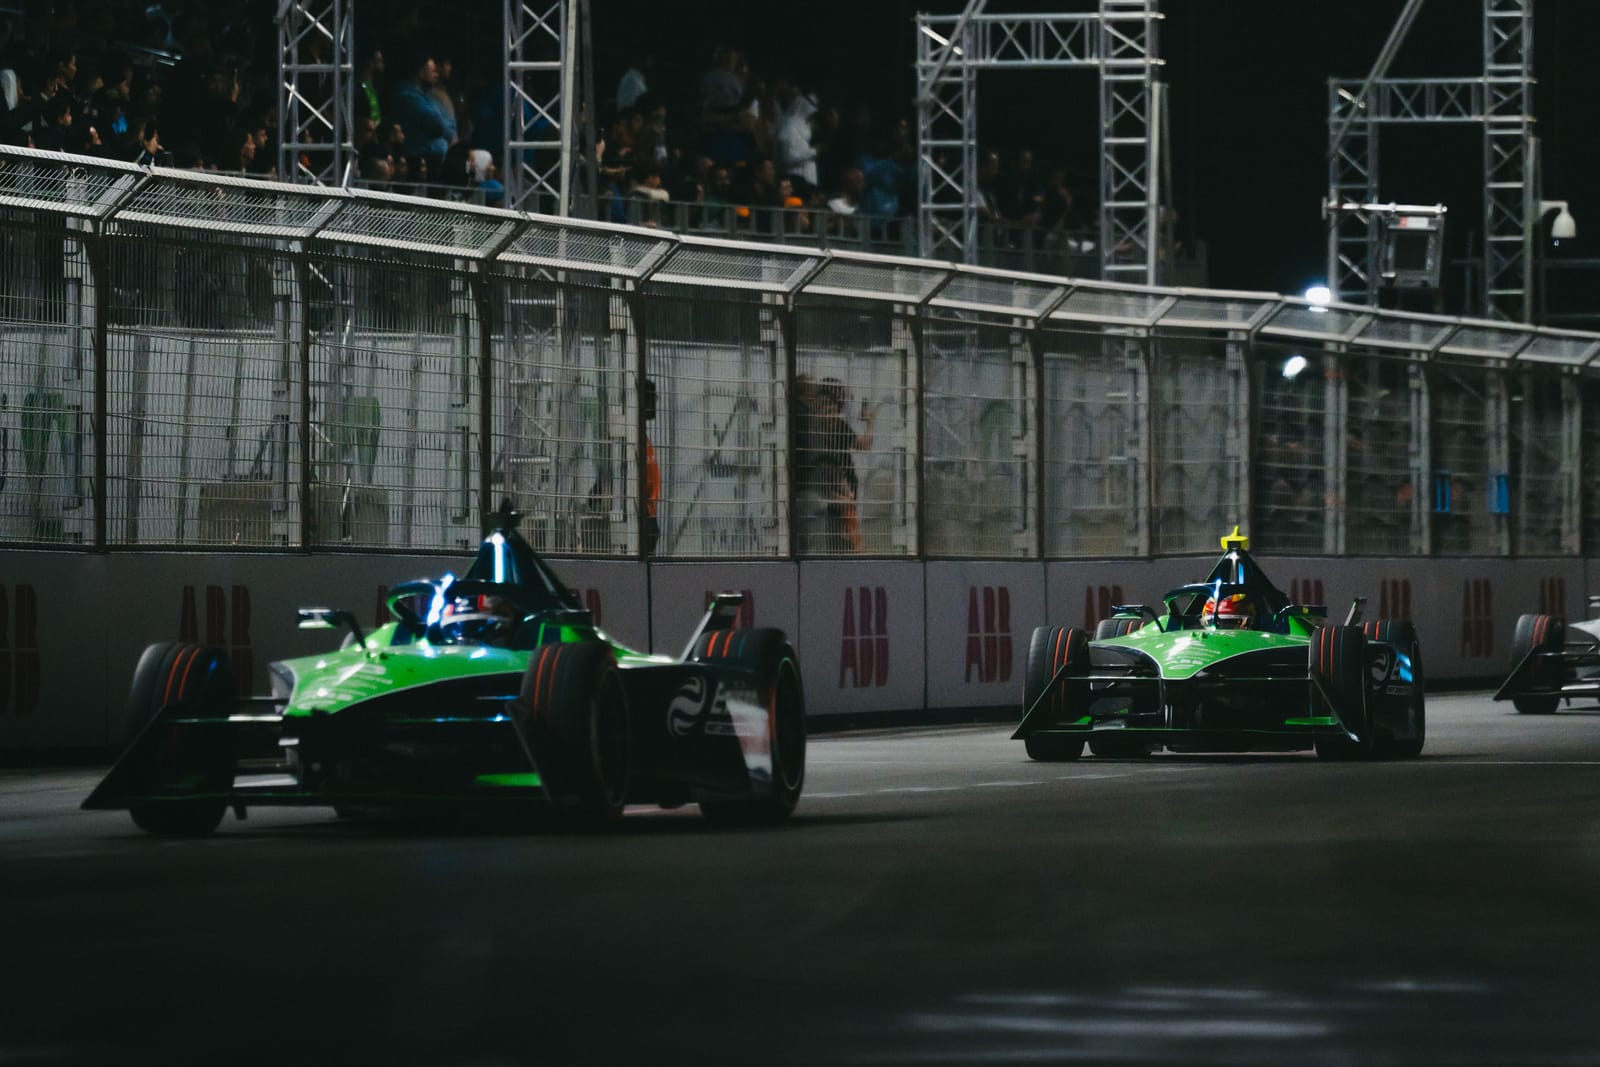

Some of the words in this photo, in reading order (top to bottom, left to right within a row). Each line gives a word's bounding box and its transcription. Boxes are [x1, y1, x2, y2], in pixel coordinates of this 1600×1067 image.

[839, 586, 889, 688] ABB
[965, 586, 1012, 683] ABB
[1463, 579, 1493, 657] ABB
